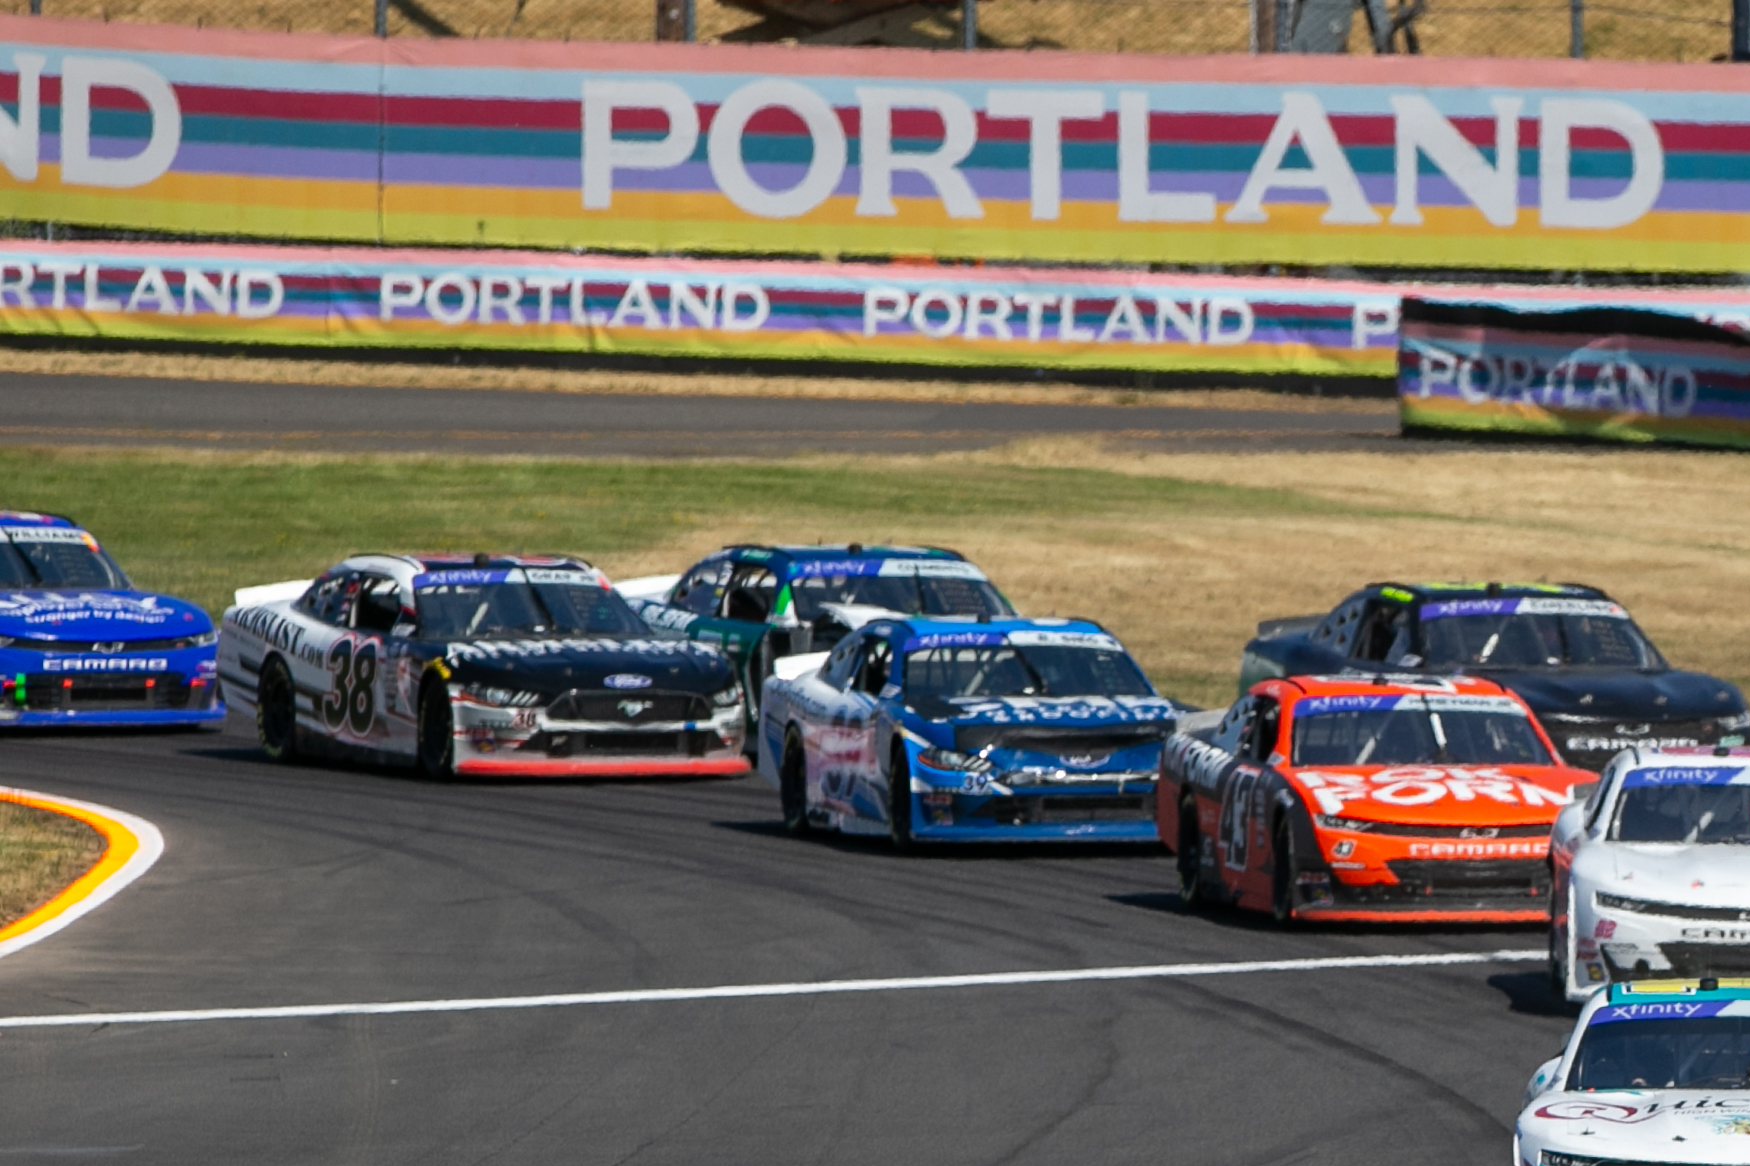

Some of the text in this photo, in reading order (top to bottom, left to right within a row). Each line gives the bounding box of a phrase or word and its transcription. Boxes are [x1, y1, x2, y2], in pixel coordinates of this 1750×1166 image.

[581, 78, 1664, 229] PORTLAND
[379, 271, 771, 332] PORTLAND
[862, 285, 1254, 348] PORTLAND
[1418, 350, 1697, 418] PORTLAND
[42, 657, 168, 671] CAMARO
[322, 630, 384, 740] 38
[1308, 695, 1383, 711] xfinity
[962, 774, 989, 792] 39
[1642, 767, 1719, 784] xfinity
[1611, 1001, 1704, 1022] xfinity
